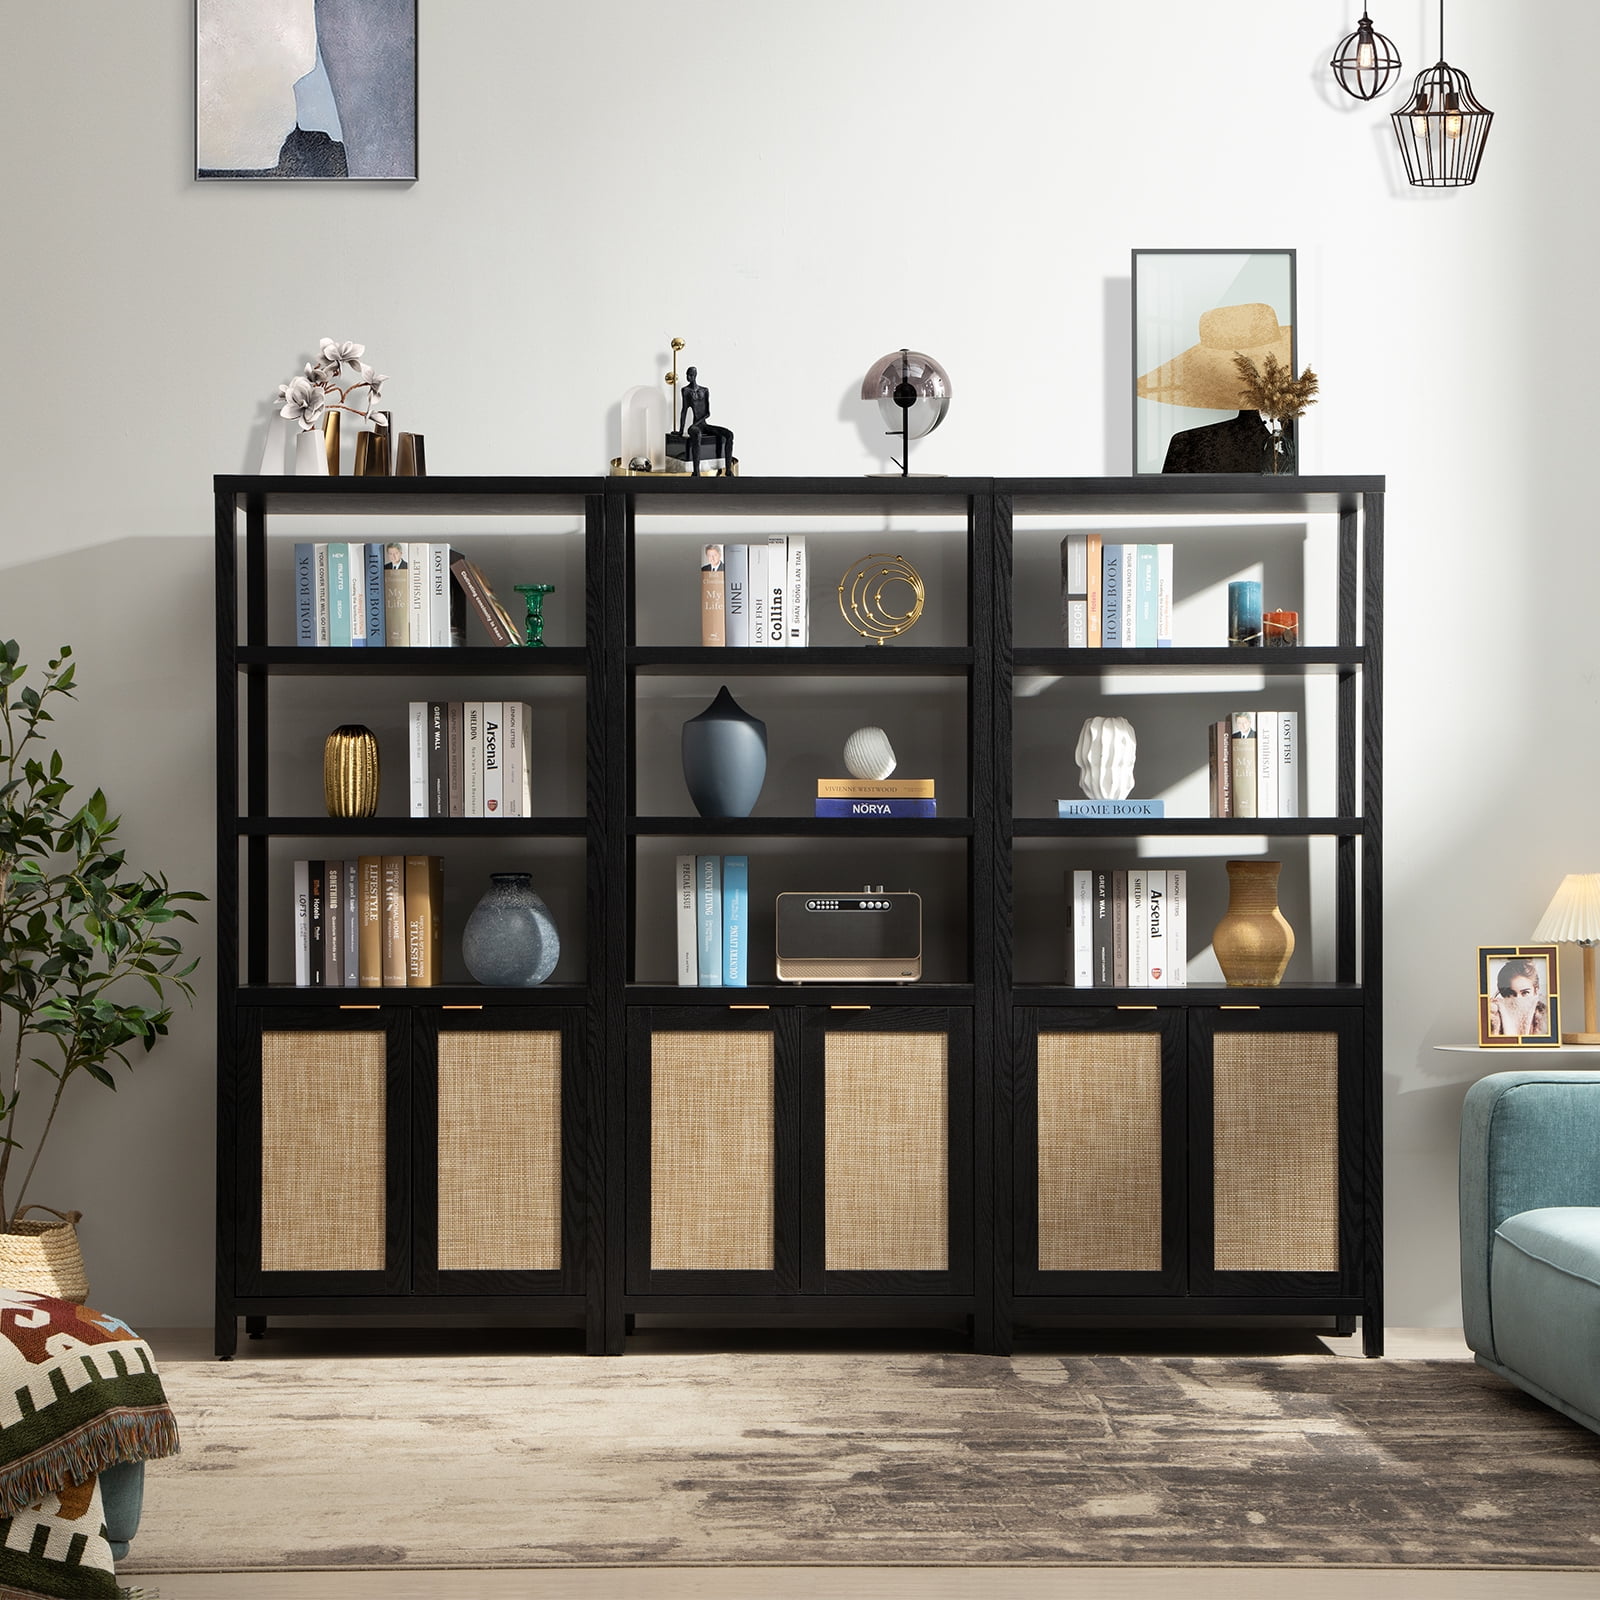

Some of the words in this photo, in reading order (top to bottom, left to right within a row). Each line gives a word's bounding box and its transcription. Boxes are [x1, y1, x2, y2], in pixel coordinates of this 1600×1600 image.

[299, 557, 310, 596] BOOK
[369, 554, 379, 596] HOME
[435, 575, 443, 596] FISH
[1107, 558, 1117, 597] BOOK
[387, 600, 406, 609] Life
[388, 588, 403, 598] My
[705, 601, 724, 610] Life
[706, 590, 722, 600] My
[731, 582, 742, 615] NINE
[300, 598, 311, 639] HOME
[320, 617, 326, 626] GO
[370, 598, 380, 636] BOOK
[755, 599, 763, 619] FISH
[771, 588, 782, 641] Collins
[1073, 604, 1082, 640] DECOR
[1107, 599, 1117, 640] HOME
[1126, 618, 1132, 626] GO
[755, 622, 763, 643] LOST
[1283, 719, 1291, 740] LOST
[486, 721, 498, 770] Arsenal
[852, 802, 891, 814] NÖRYA
[1069, 805, 1110, 815] HOME
[1113, 805, 1151, 815] BOOK
[329, 870, 338, 909] SOMETHING
[370, 864, 378, 921] LIFESTYLE
[704, 862, 713, 893] COUNTRY
[299, 894, 307, 917] LOFTS
[683, 890, 691, 909] ISSUE
[705, 893, 714, 916] LIVING
[1134, 878, 1142, 908] SHELDON
[1150, 889, 1162, 938] Arsenal
[410, 920, 418, 978] LIFESTYLE
[730, 925, 738, 948] LIVING
[729, 948, 738, 979] COUNTRY
